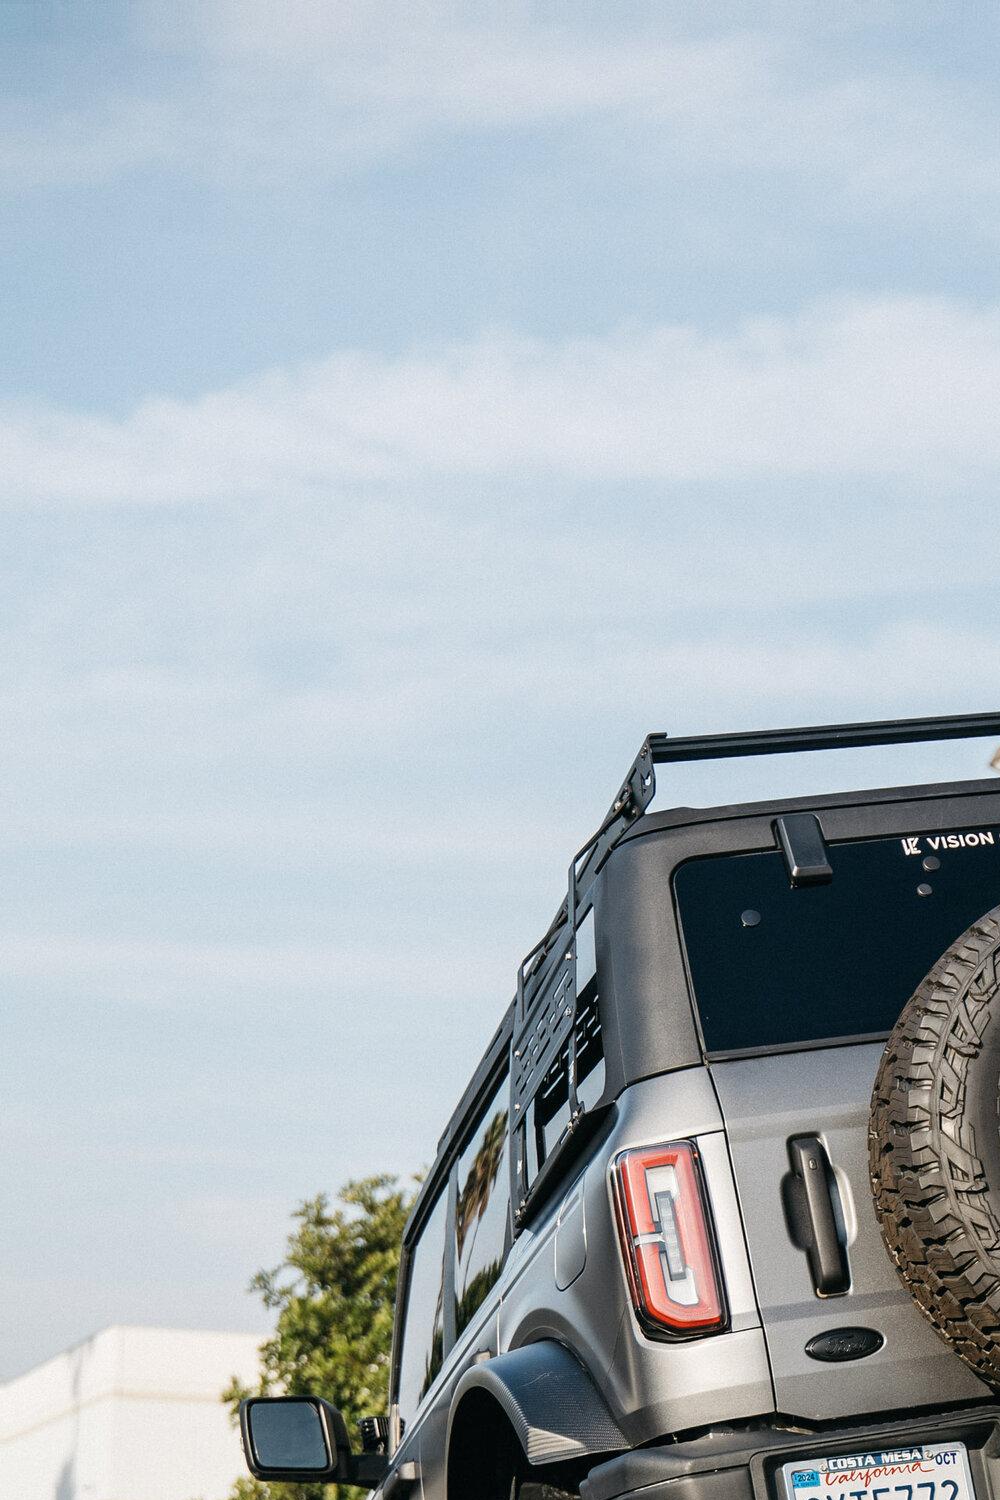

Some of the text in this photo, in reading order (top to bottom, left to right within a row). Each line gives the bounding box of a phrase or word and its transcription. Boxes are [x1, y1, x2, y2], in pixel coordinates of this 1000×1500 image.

[926, 831, 995, 851] VISION
[828, 1448, 923, 1471] COSTA MESA
[934, 1451, 957, 1466] OCT
[797, 1472, 816, 1483] 2024
